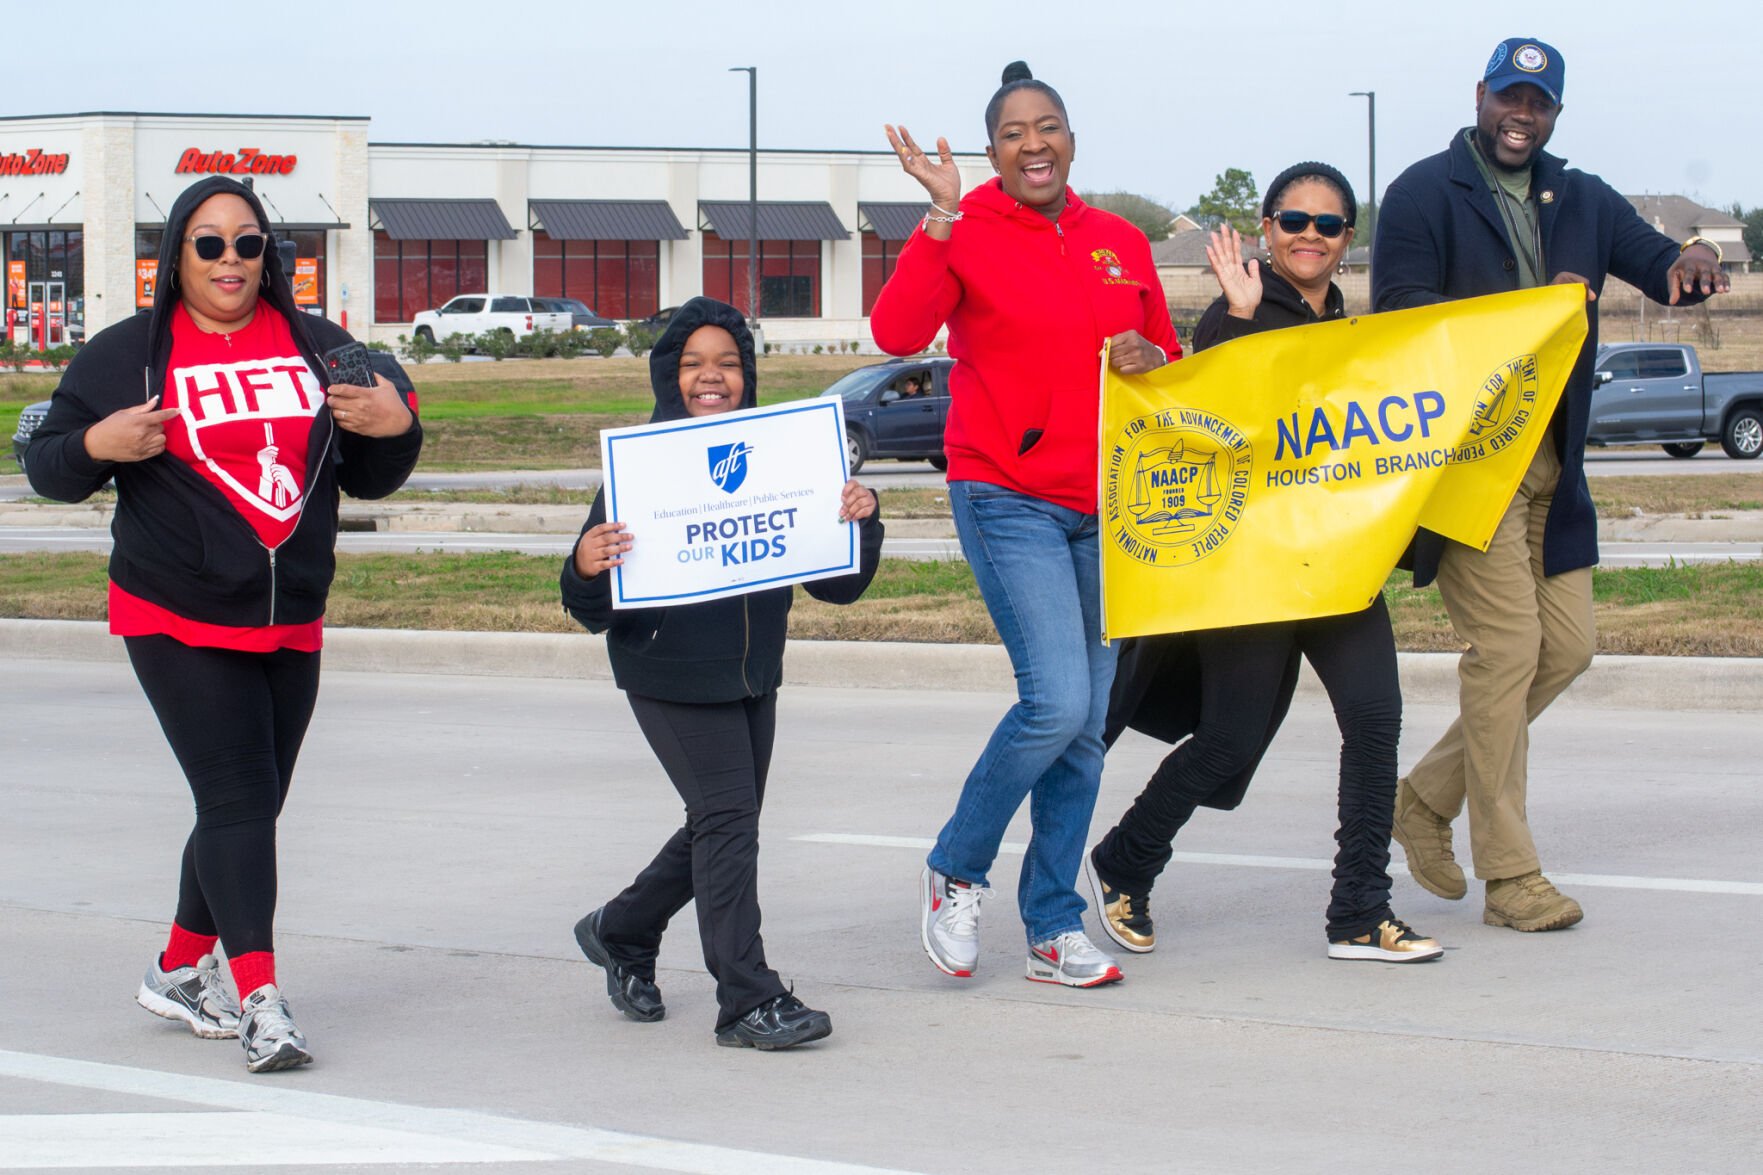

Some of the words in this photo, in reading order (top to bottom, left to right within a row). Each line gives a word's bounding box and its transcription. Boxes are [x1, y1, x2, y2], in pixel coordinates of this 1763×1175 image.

[0, 148, 69, 176] utoZone
[174, 147, 298, 175] AutoZone
[184, 365, 311, 421] HFT
[1484, 373, 1505, 396] FOR
[1523, 390, 1536, 403] OF
[1124, 419, 1147, 439] FOR
[1155, 411, 1175, 428] THE
[1179, 410, 1249, 453] ADVANCEMENT
[1274, 390, 1446, 461] NAACP
[1489, 409, 1530, 451] COLORED
[712, 441, 754, 490] aft
[1151, 466, 1198, 488] NAACP
[1266, 461, 1361, 488] HOUSTON
[1375, 448, 1455, 475] BRANCH
[1108, 445, 1125, 522] ASSOCIATION
[1224, 470, 1249, 523] COLORED
[654, 505, 698, 520] Education
[703, 498, 748, 513] Healthcare
[753, 490, 779, 505] Public
[780, 487, 815, 500] Services
[1162, 495, 1185, 509] 1909
[686, 507, 798, 545] PROTECT
[1191, 523, 1229, 557] PEOPLE
[677, 546, 715, 564] OUR
[721, 534, 787, 567] KIDS
[1115, 525, 1158, 563] NATIONAL
